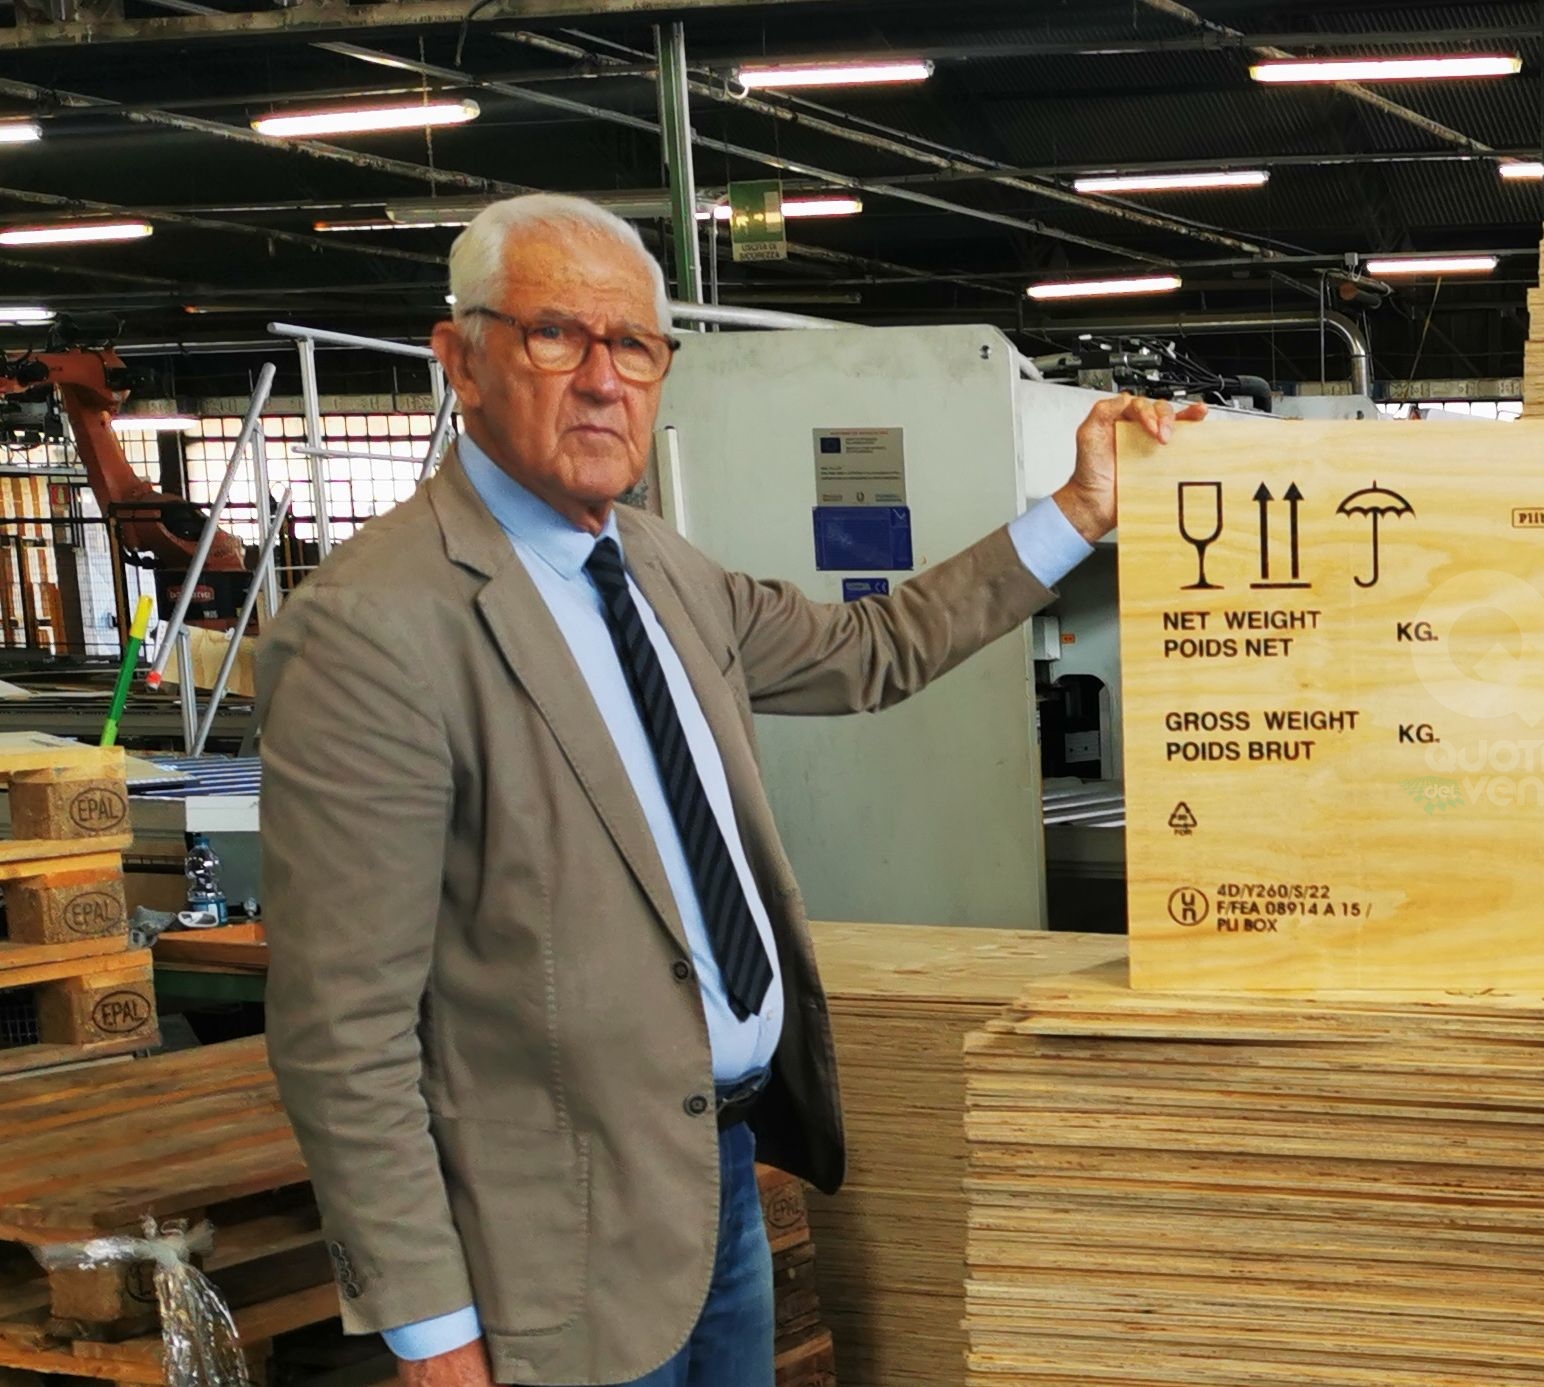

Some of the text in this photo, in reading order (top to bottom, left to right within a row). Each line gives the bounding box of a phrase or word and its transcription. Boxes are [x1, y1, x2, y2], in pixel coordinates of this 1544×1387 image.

[1163, 610, 1321, 630] NET WEIGHT
[1396, 622, 1438, 641] KG.
[1164, 638, 1293, 658] POIDS NET
[1165, 710, 1359, 731] GROSS WEIGHT
[1398, 724, 1440, 743] KG.
[1166, 740, 1315, 761] POIDS BRUT
[78, 796, 119, 821] EPAL
[1216, 884, 1330, 900] 4D/Y260/S/22
[72, 900, 114, 927] EPAL
[1216, 901, 1261, 915] F/FEA
[1265, 902, 1318, 916] 08914
[1323, 902, 1335, 916] A
[1342, 902, 1361, 917] 15
[1243, 918, 1278, 932] BOX
[101, 1000, 147, 1026] EPAL
